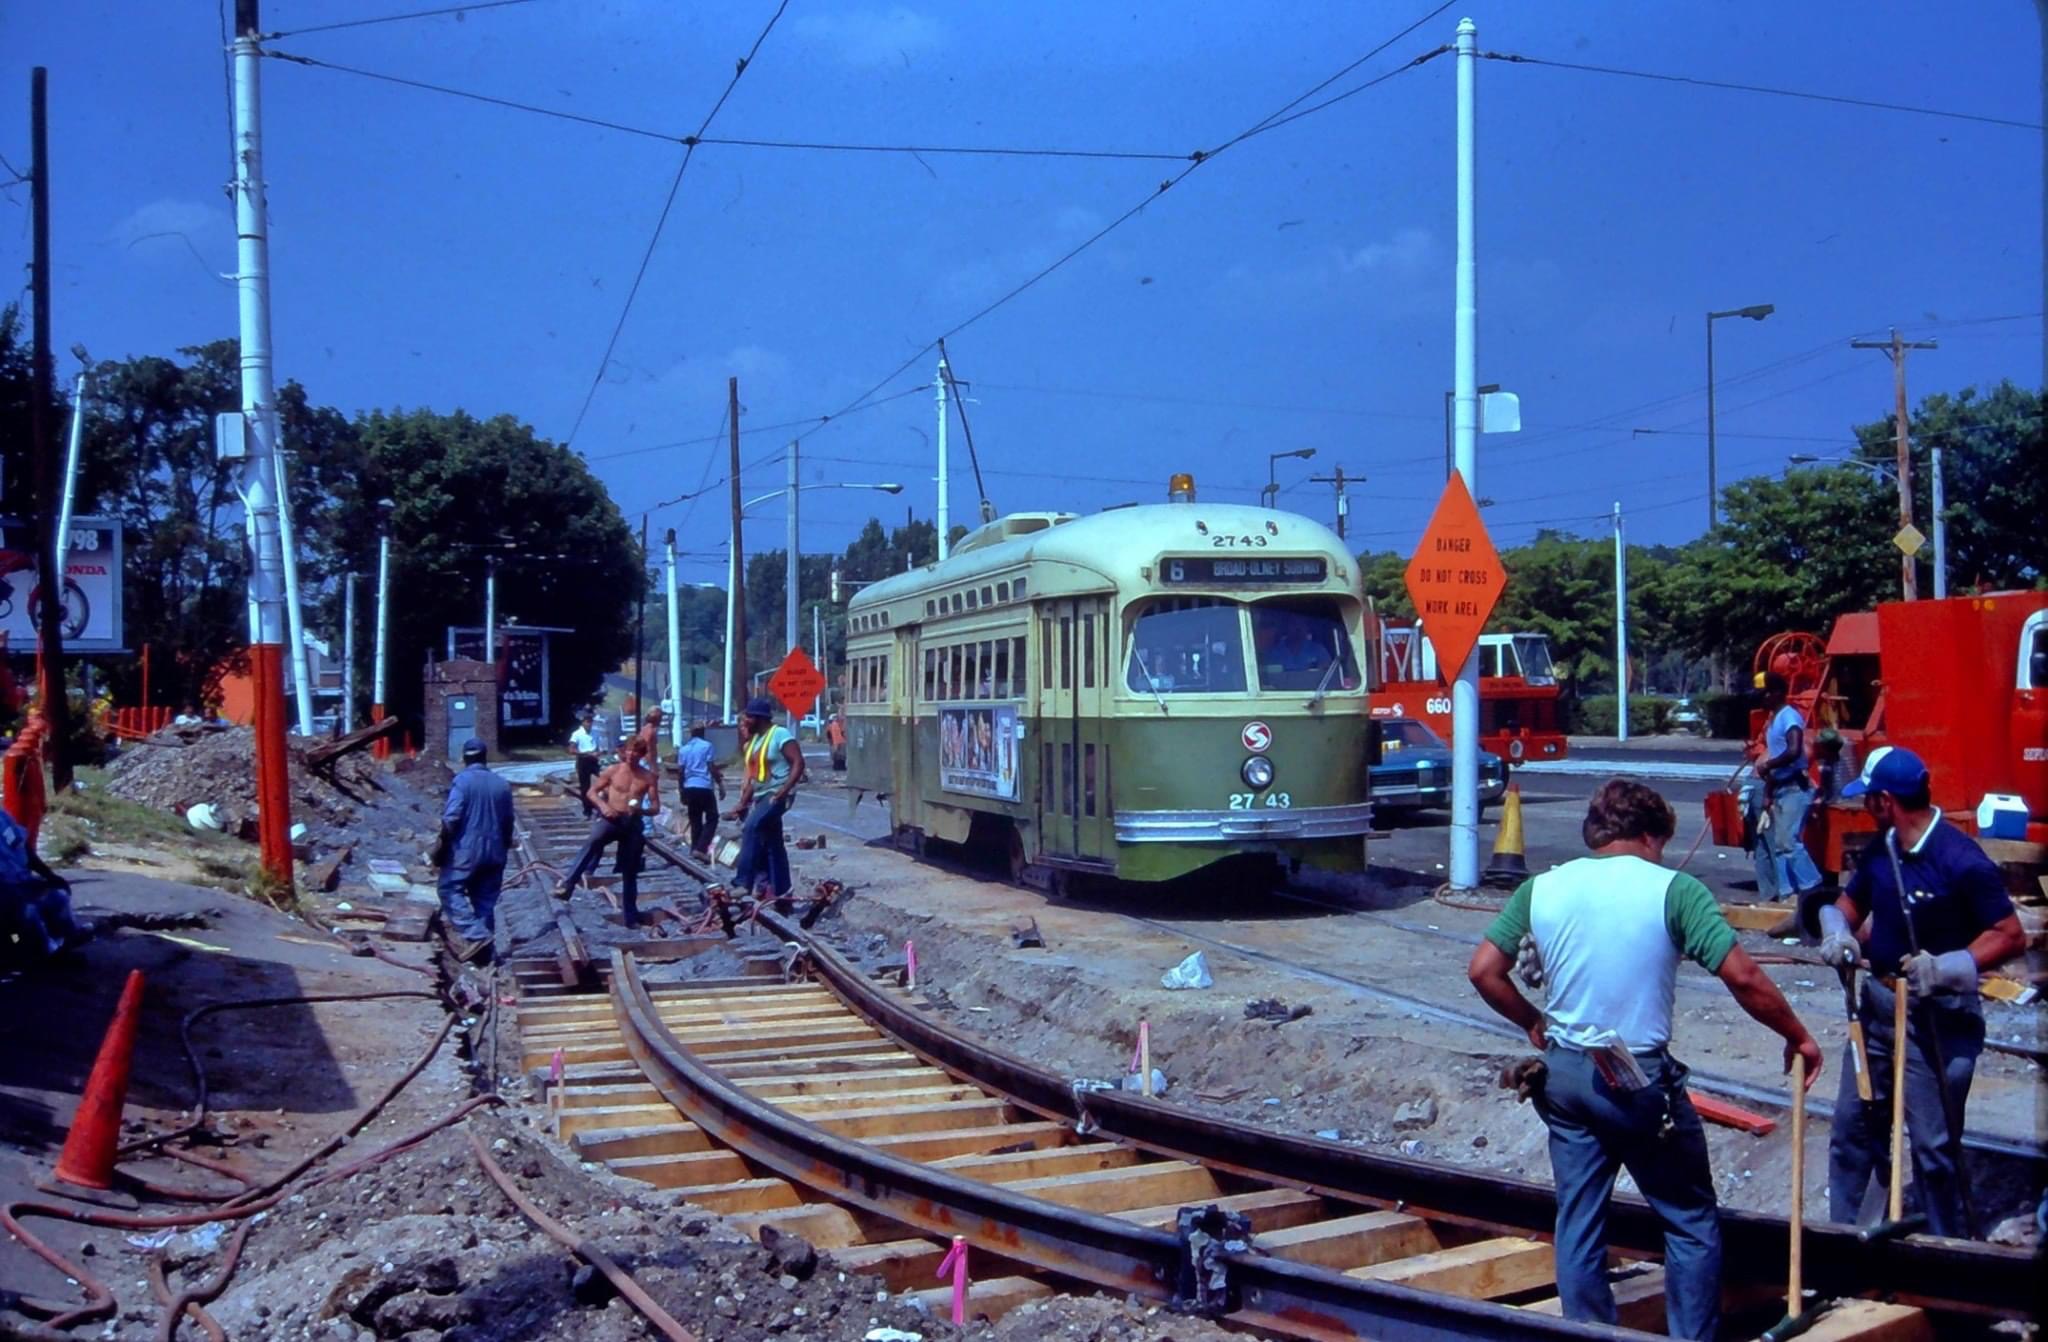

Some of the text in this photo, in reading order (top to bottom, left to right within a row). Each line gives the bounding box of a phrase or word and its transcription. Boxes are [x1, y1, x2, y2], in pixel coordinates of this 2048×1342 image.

[1212, 535, 1268, 547] 2743
[1436, 537, 1471, 552] DANGER
[1170, 560, 1184, 581] 6
[1420, 569, 1487, 584] DO NOT CROSS
[1426, 600, 1478, 616] WORK AREA
[1426, 698, 1451, 714] 660
[1229, 793, 1290, 810] 27 43
